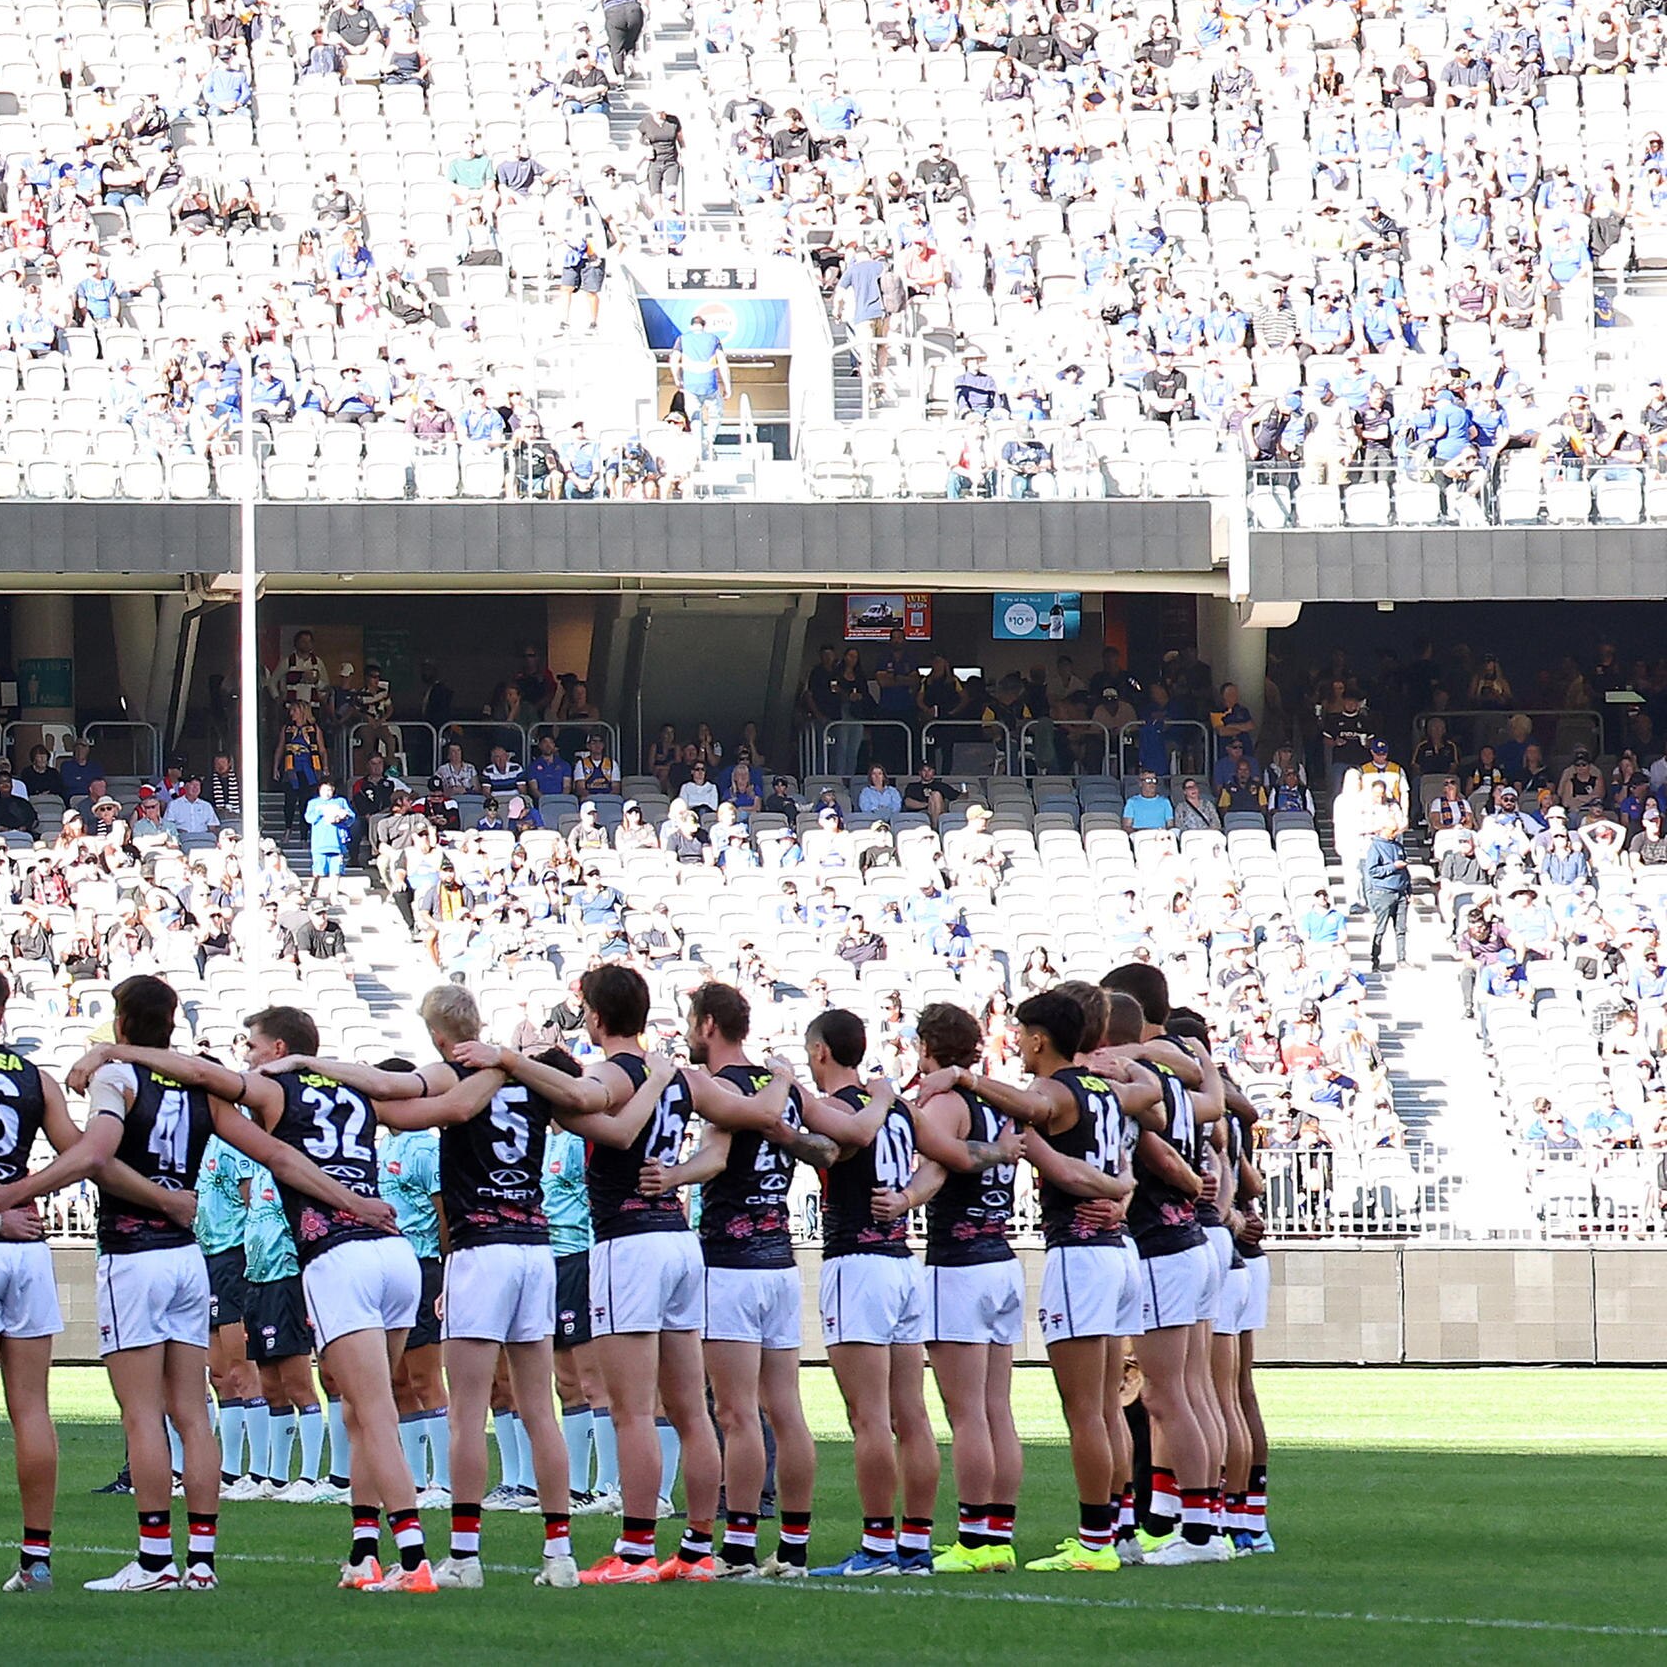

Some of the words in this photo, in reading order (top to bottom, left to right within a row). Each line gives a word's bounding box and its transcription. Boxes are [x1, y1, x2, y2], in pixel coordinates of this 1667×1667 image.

[301, 1086, 372, 1162] 32
[490, 1086, 530, 1164] 5
[874, 1112, 915, 1193] 40
[1085, 1093, 1122, 1175] 34
[477, 1187, 537, 1200] CHERY
